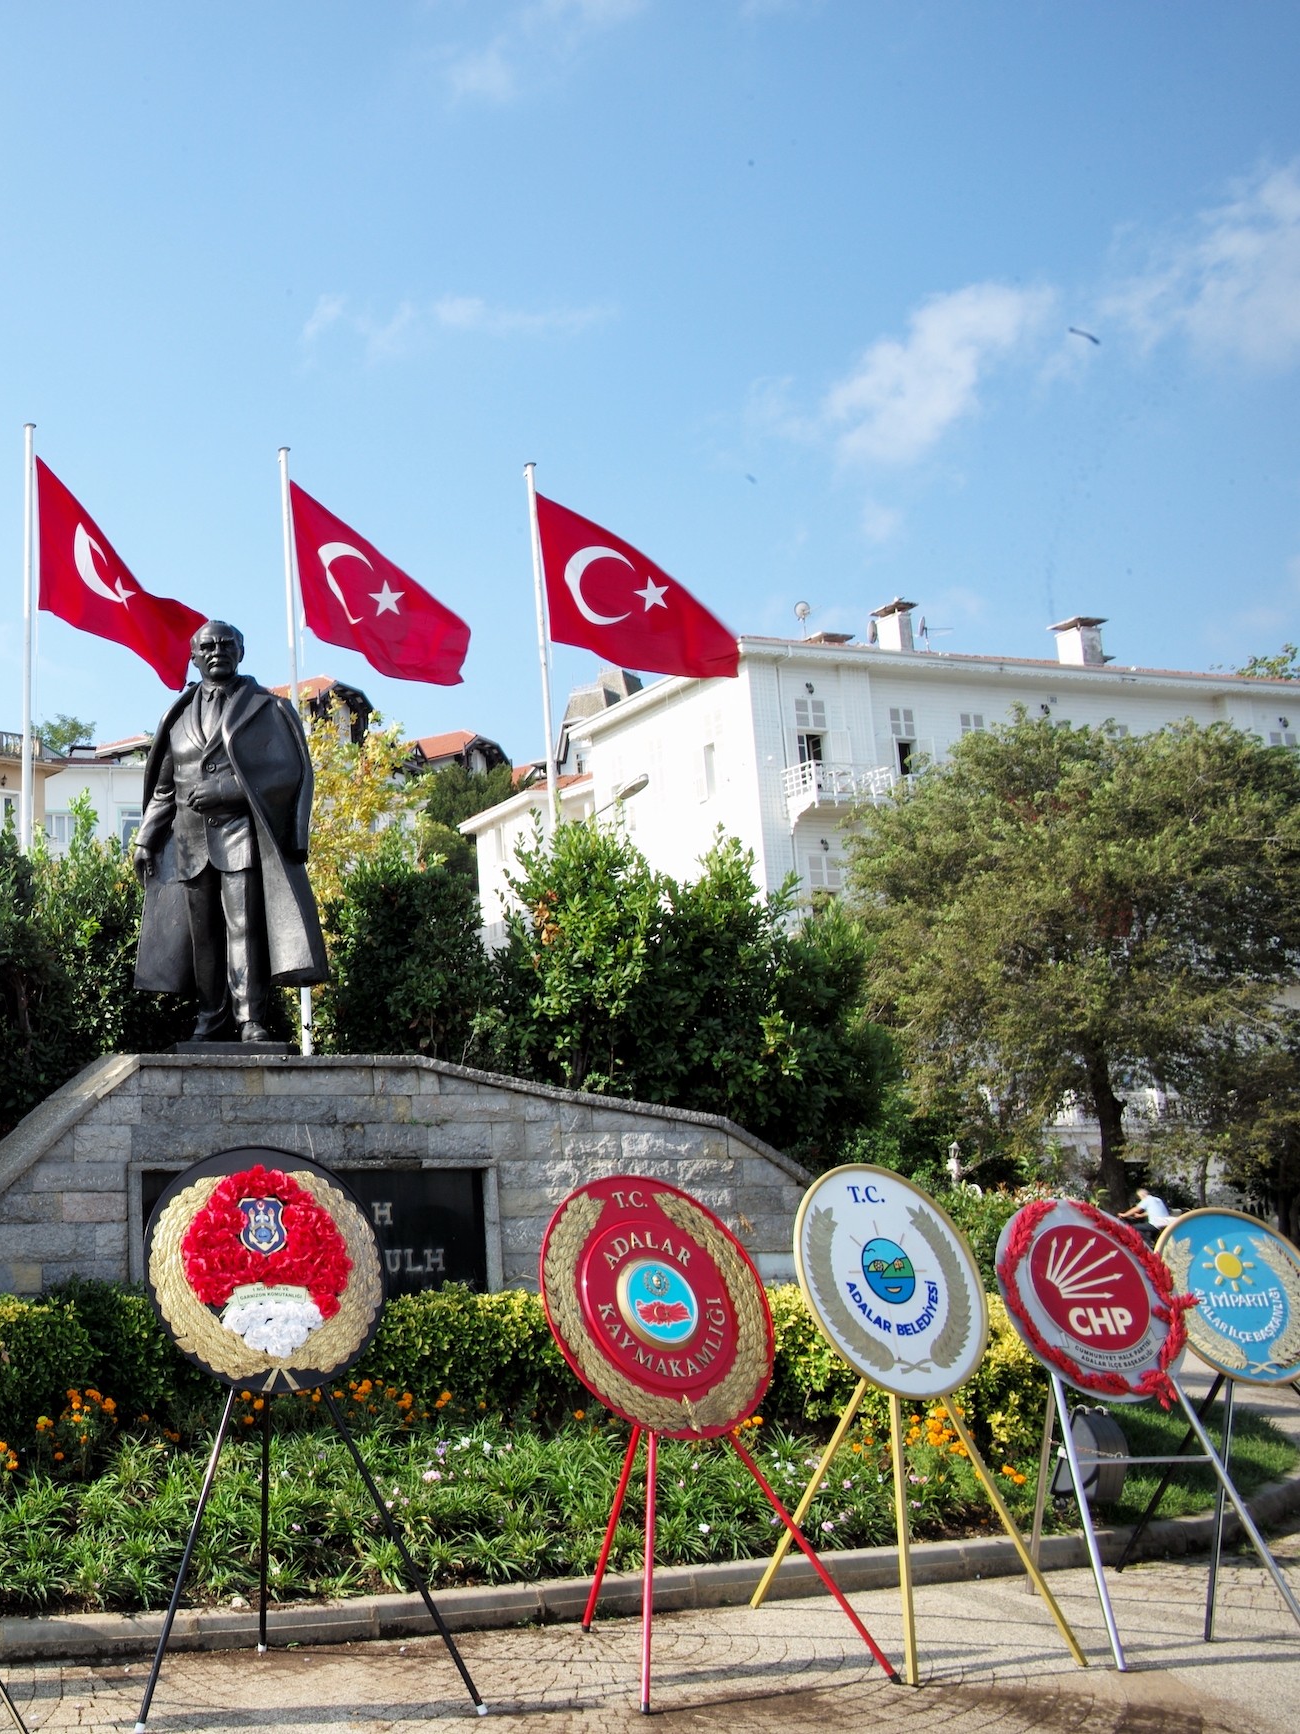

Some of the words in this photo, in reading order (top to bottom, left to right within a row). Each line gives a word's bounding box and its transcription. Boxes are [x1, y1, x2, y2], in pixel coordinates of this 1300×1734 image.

[611, 1190, 649, 1208] T.C.
[847, 1186, 885, 1203] T.C.
[603, 1231, 691, 1270] ADALAR
[846, 1281, 892, 1333] ADALAR
[896, 1280, 938, 1336] BELEDİYESİ
[1068, 1307, 1133, 1336] CHP
[1195, 1288, 1229, 1333] ADALAR
[1253, 1287, 1284, 1343] BAŞKANLIĞI
[598, 1298, 725, 1377] KAYMAKAMLIĞI
[1075, 1345, 1117, 1361] CUMHURİYET
[1081, 1355, 1107, 1367] ADALAR
[1108, 1360, 1122, 1370] İLÇE
